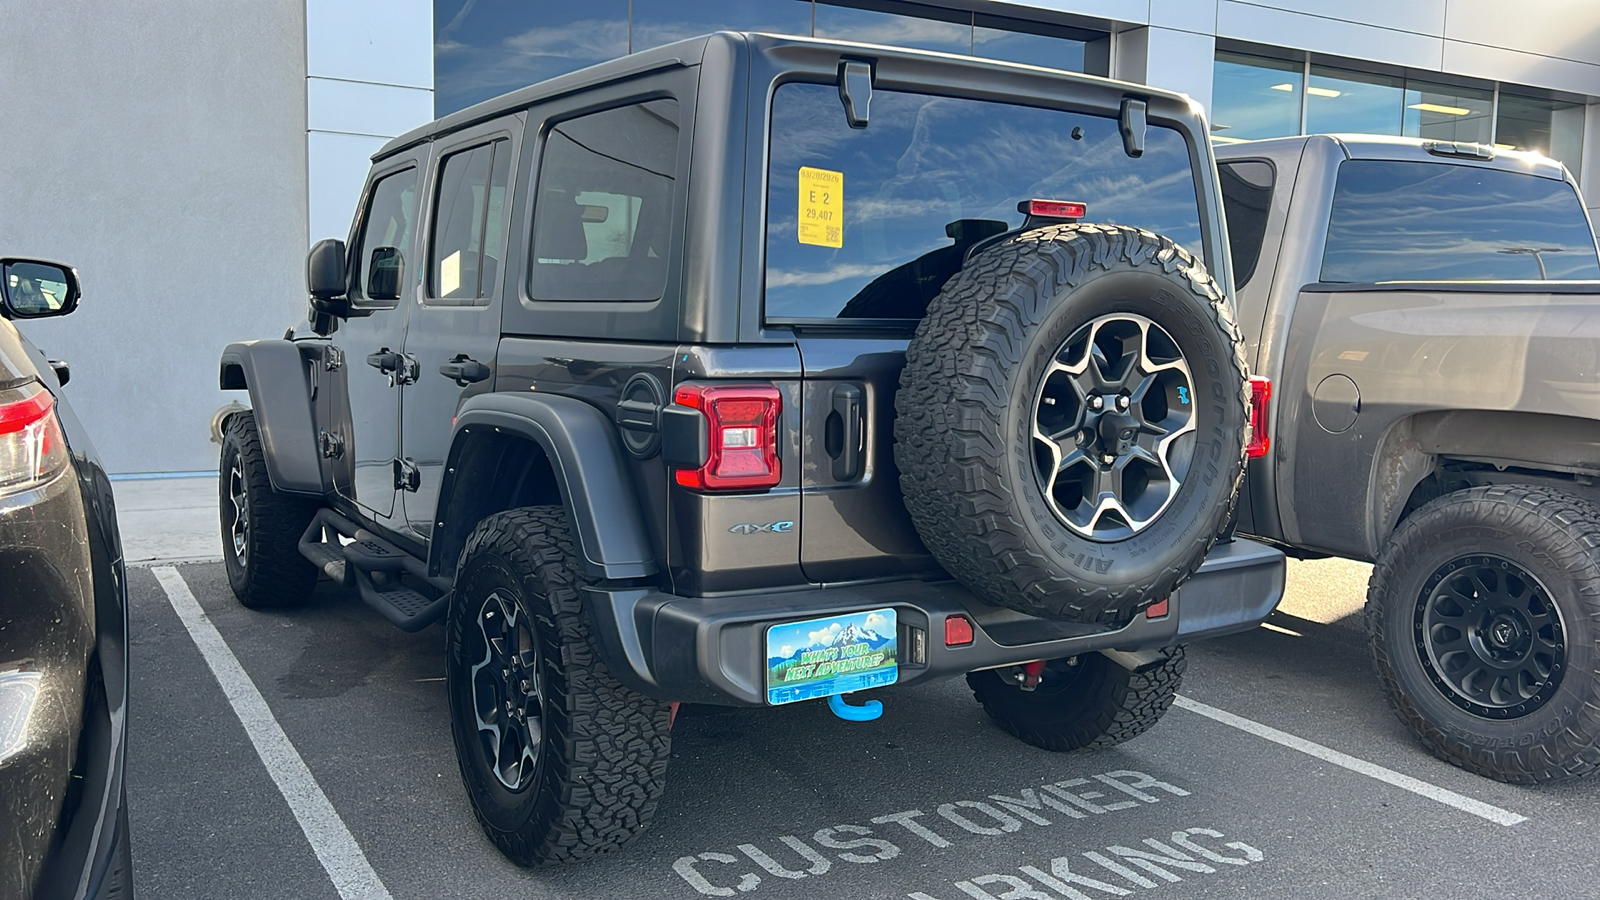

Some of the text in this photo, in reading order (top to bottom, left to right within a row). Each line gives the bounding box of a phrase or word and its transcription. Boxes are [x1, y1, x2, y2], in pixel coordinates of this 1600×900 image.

[800, 170, 839, 183] 03/20/2026
[809, 190, 830, 205] E 2
[806, 208, 833, 221] 29,407
[1149, 287, 1228, 488] BFGoodrich
[841, 642, 870, 658] YOUR
[784, 653, 885, 682] NEXT ADVENTURE?
[671, 769, 1192, 897] CUSTOMER
